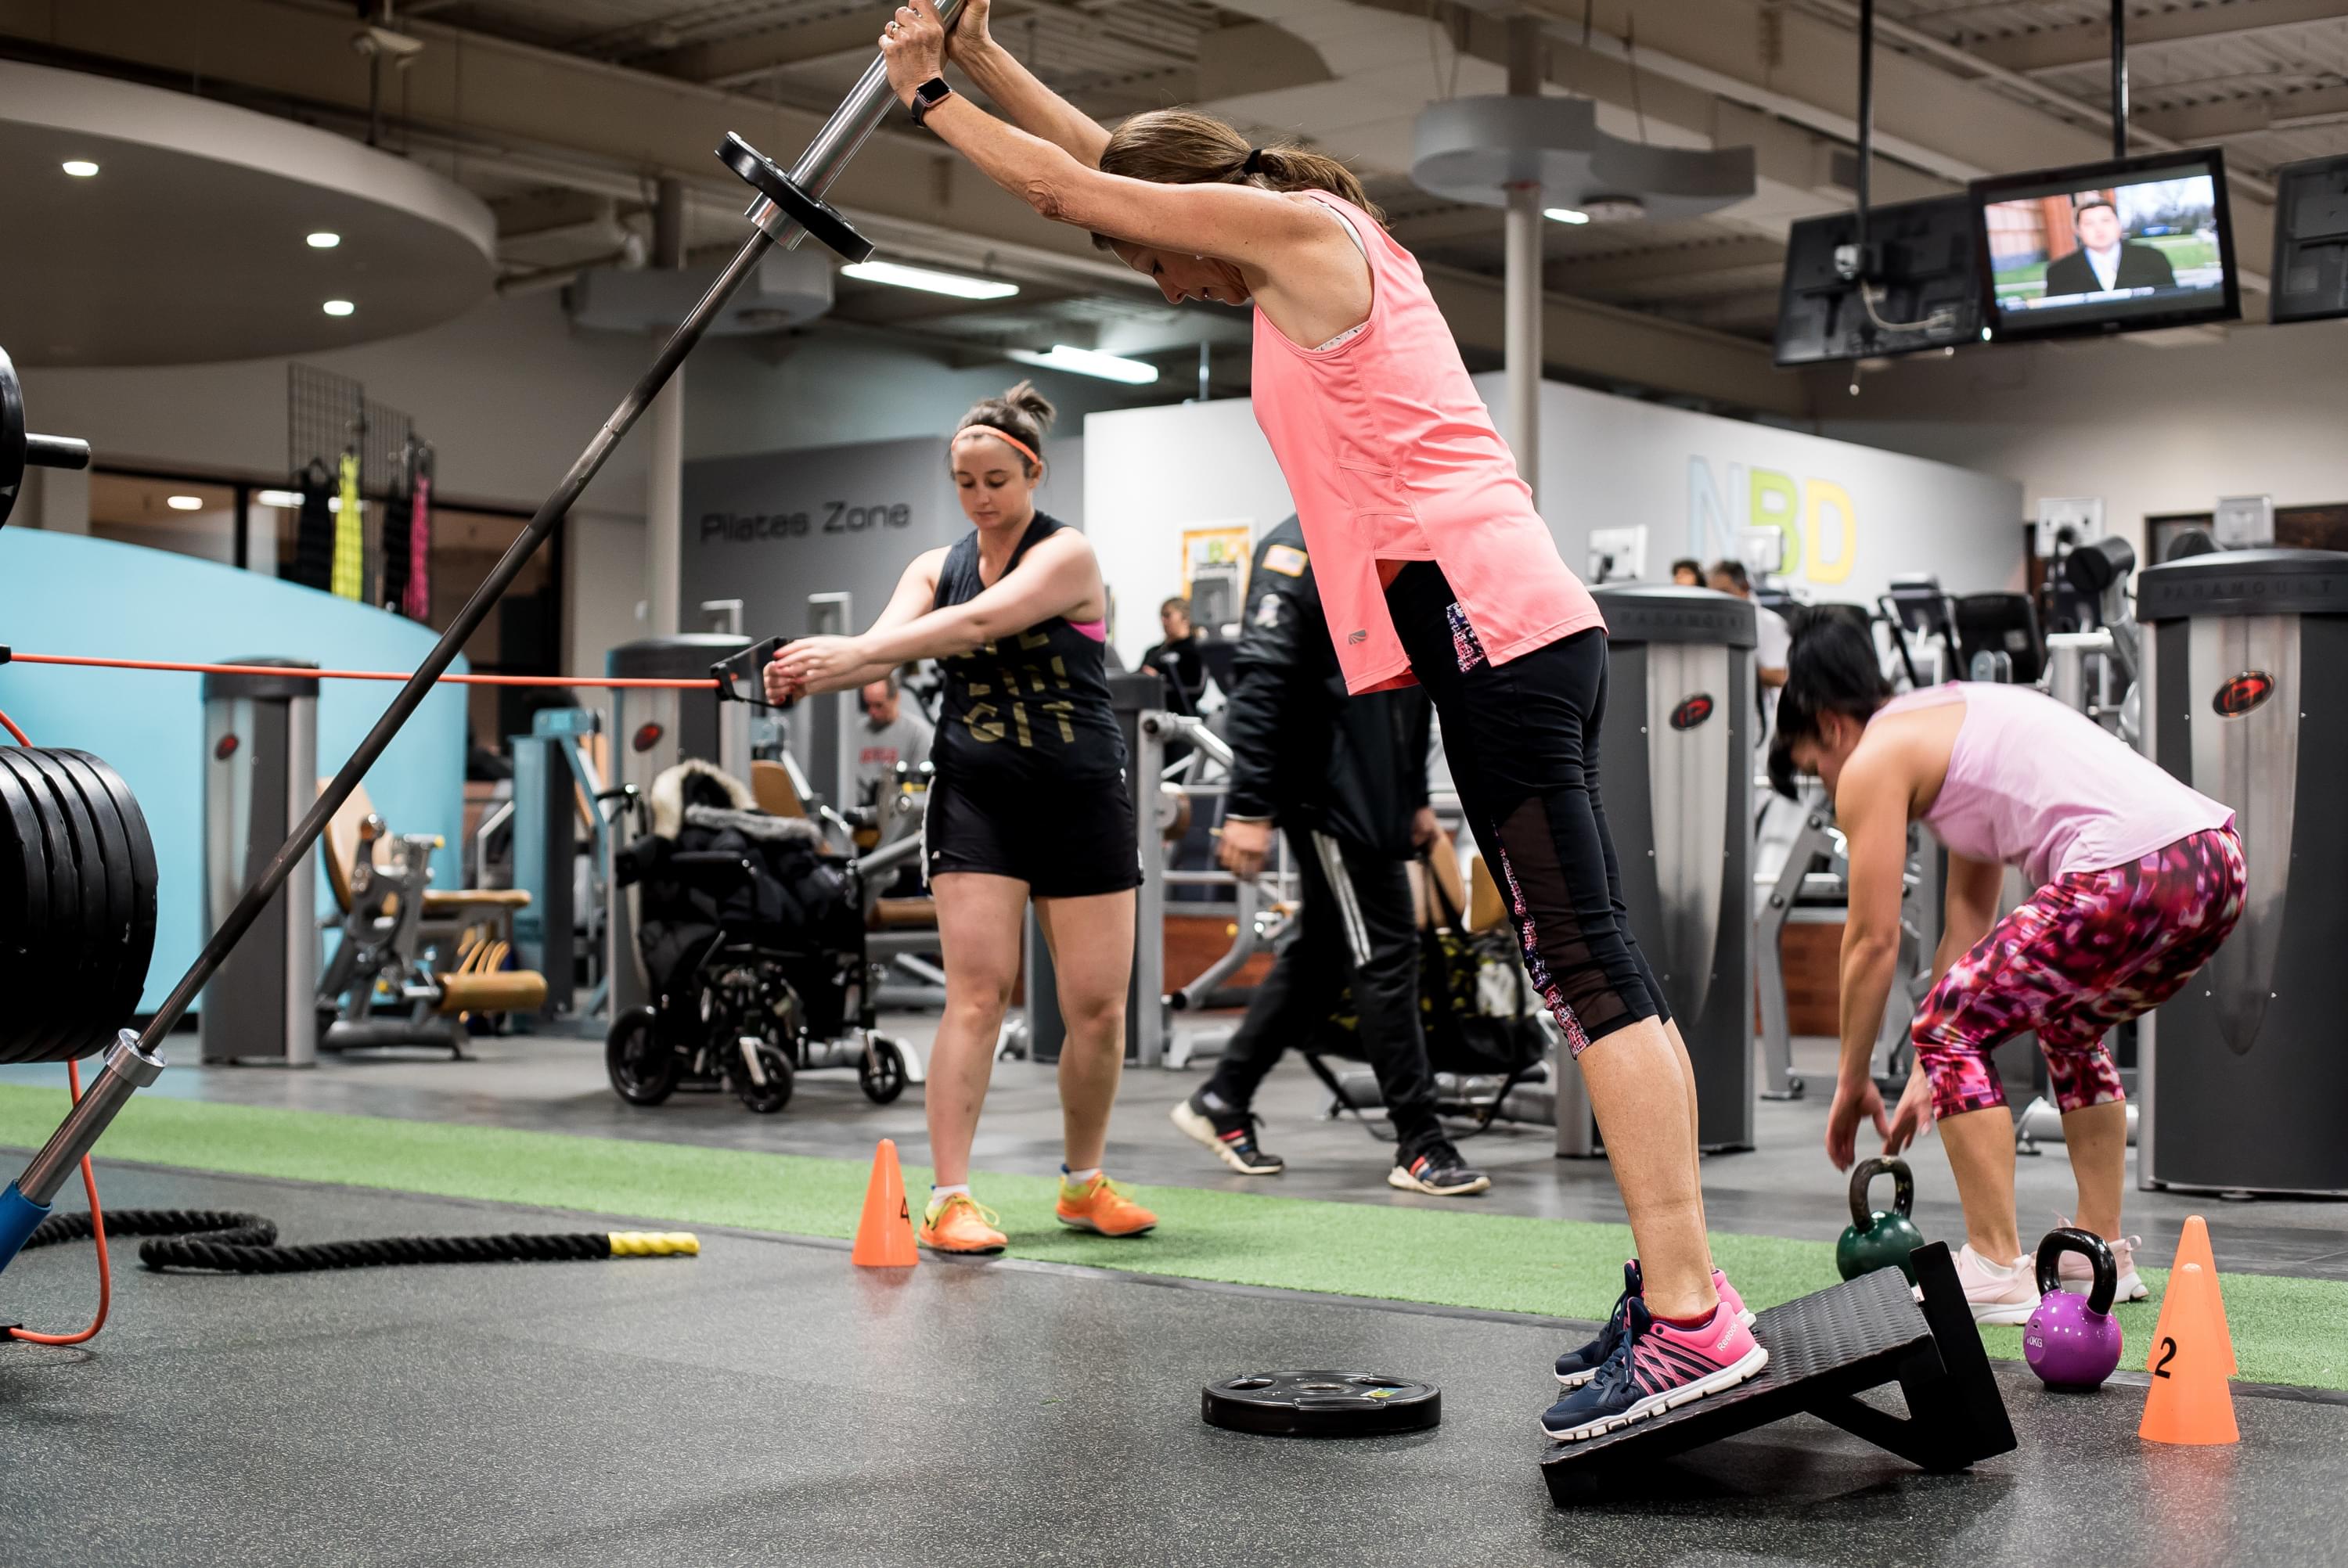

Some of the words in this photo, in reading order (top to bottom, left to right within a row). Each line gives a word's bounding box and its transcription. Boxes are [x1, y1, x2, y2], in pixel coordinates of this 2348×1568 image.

[700, 512, 810, 542] Pilates
[823, 501, 910, 534] Zone
[1688, 454, 1857, 585] NBD
[900, 1196, 910, 1225] 4
[1716, 1322, 1739, 1352] Reebok
[2155, 1336, 2177, 1379] 2
